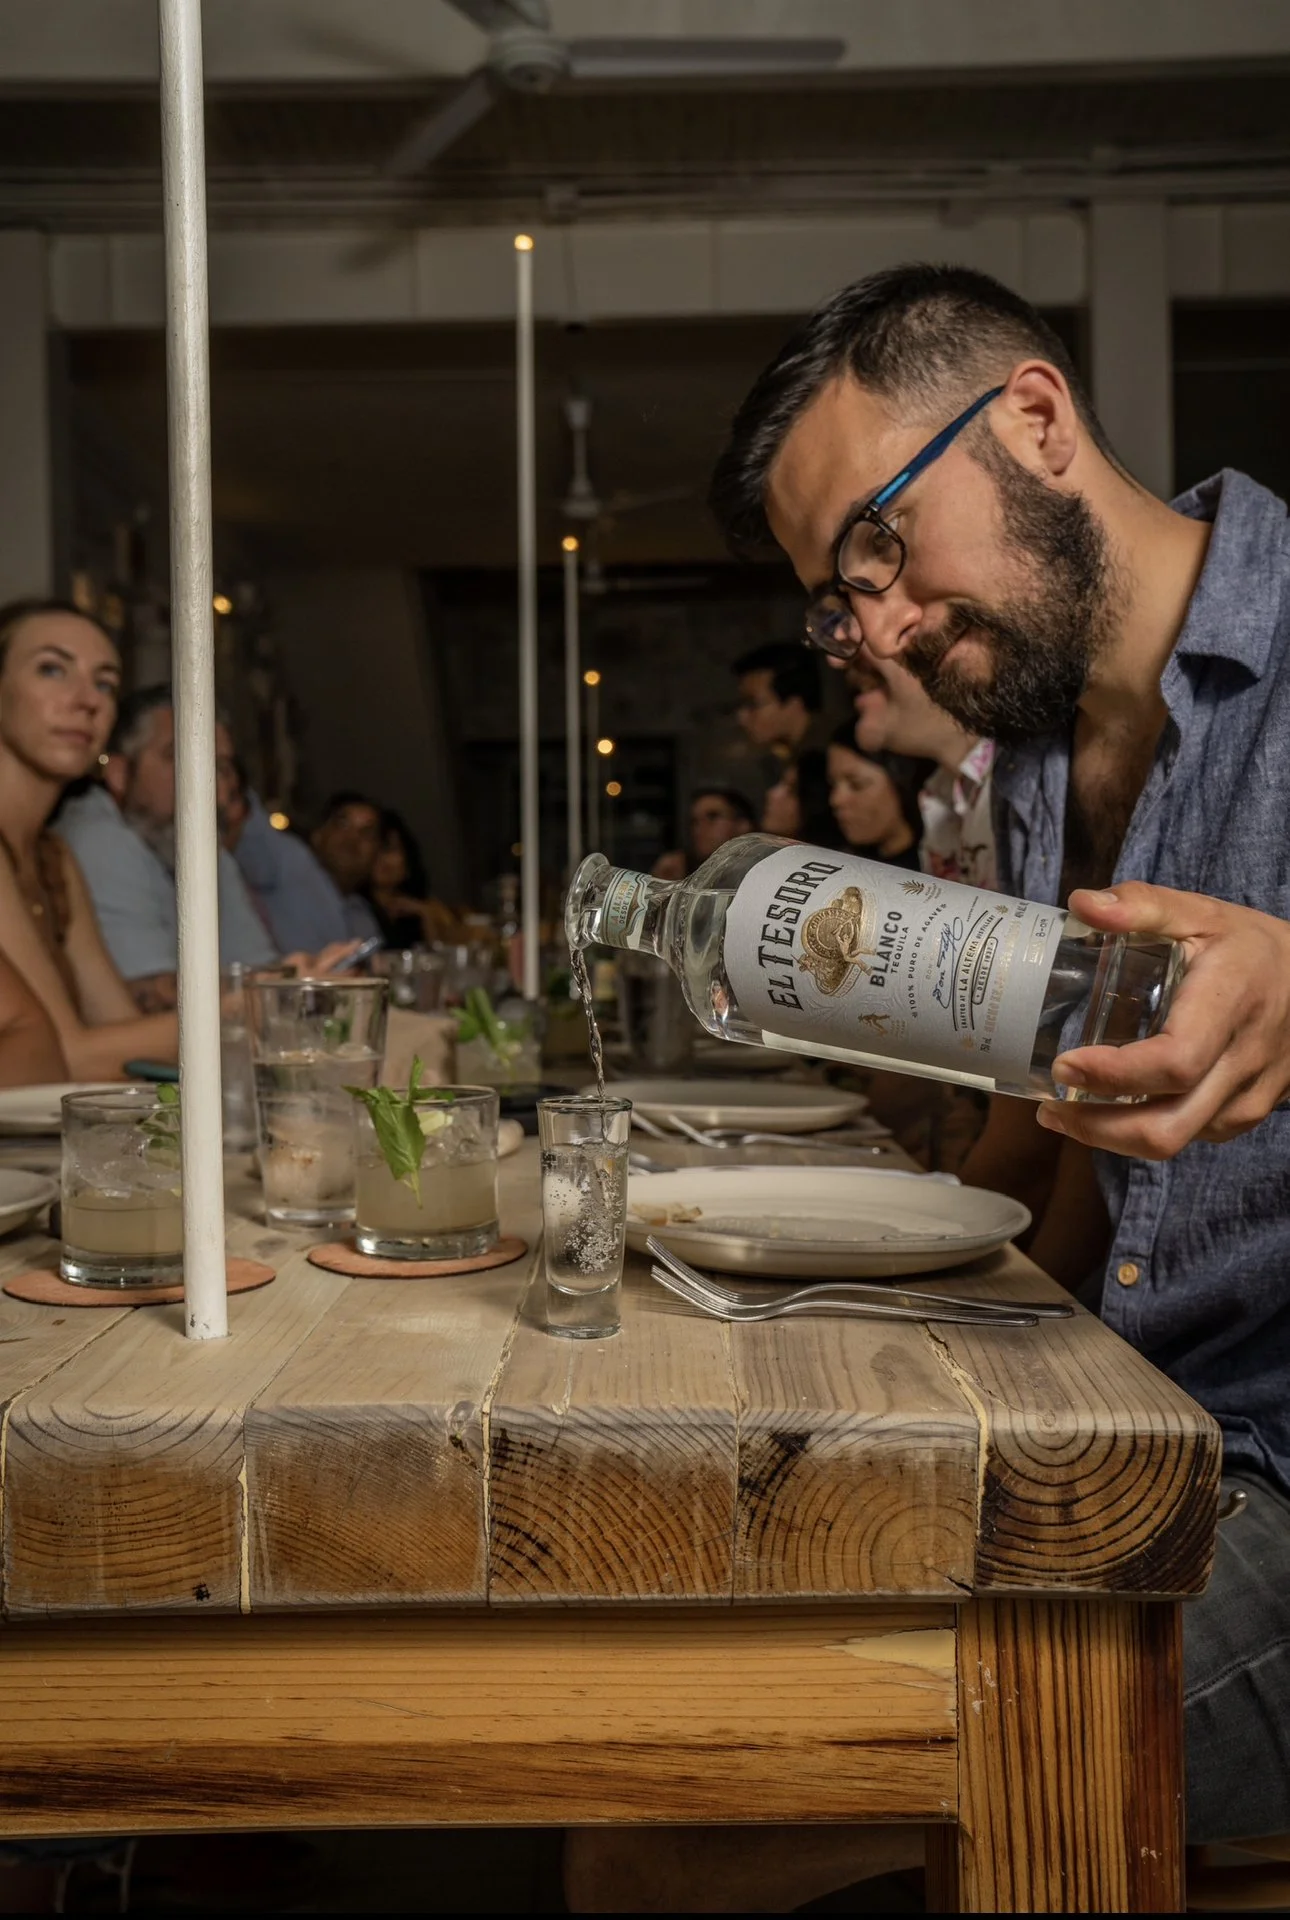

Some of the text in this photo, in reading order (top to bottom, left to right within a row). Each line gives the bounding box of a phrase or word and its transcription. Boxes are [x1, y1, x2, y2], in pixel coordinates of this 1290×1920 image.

[618, 902, 630, 924] DESDE
[758, 861, 842, 968] TESORO
[870, 911, 902, 987] BLANCO
[890, 926, 909, 974] TEQUILA
[914, 936, 923, 948] DE
[958, 978, 968, 991] LA
[975, 914, 995, 940] DISTILLERY
[908, 952, 917, 979] PURO
[977, 966, 989, 991] DESDE
[767, 975, 804, 1011] EL
[908, 985, 917, 1010] 100%
